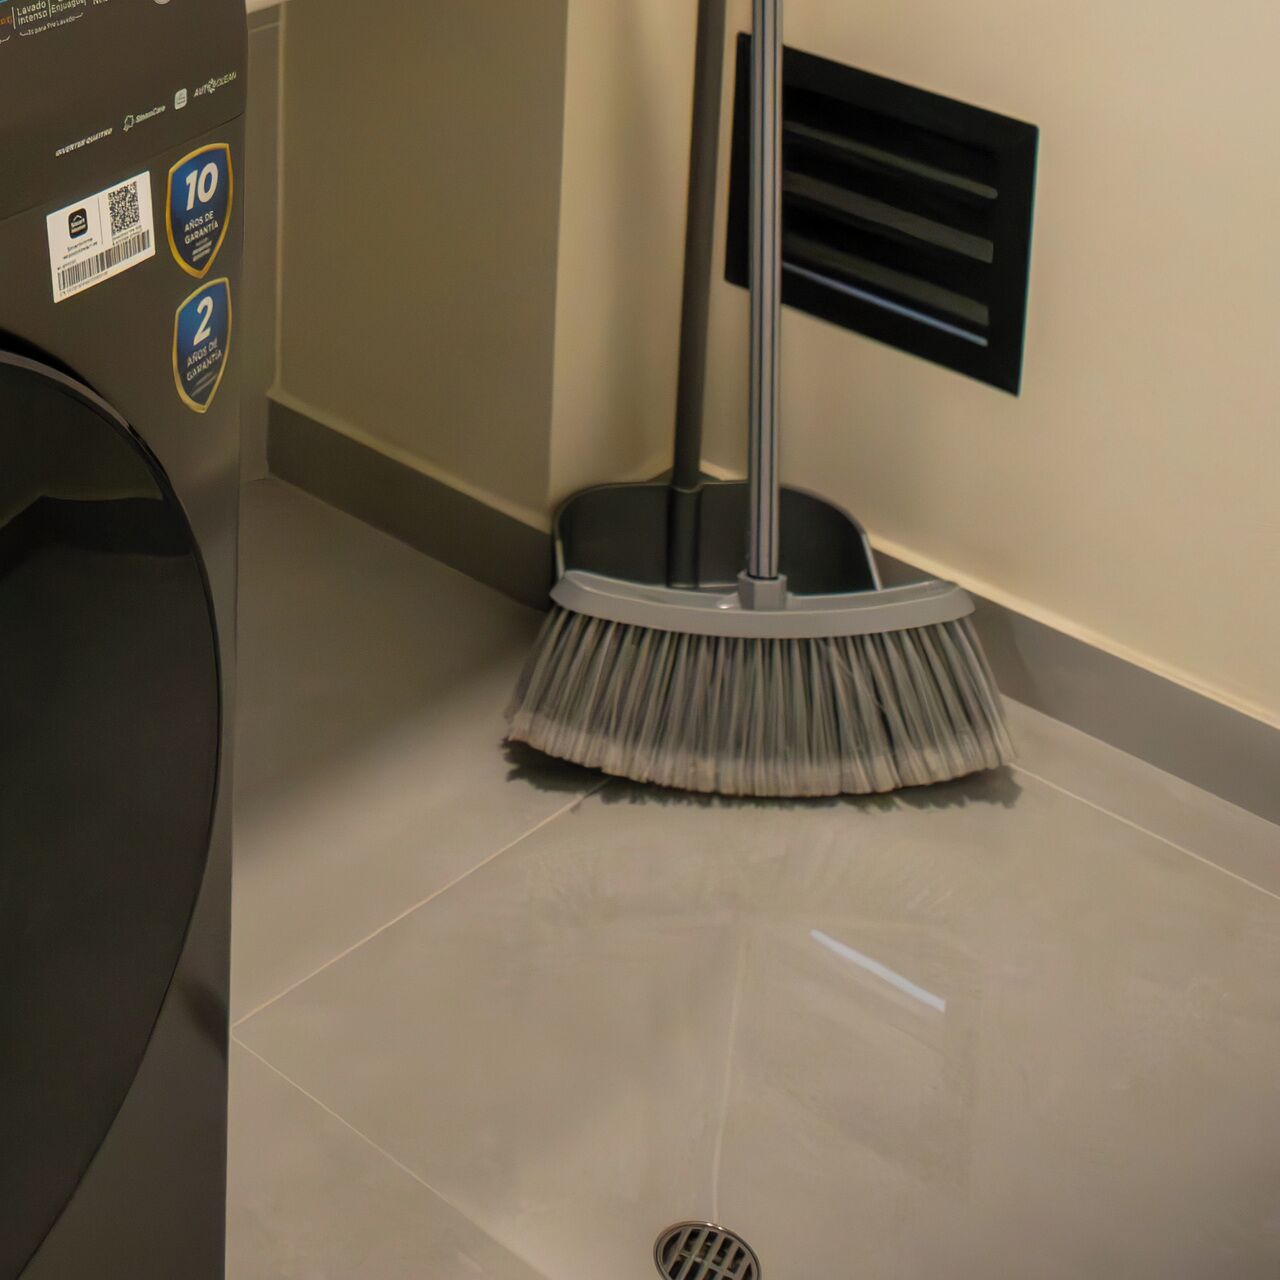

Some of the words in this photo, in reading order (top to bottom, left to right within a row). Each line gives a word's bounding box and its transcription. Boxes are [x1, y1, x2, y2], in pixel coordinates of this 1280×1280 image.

[17, 1, 47, 16] Lavado
[18, 10, 48, 26] Intenso
[186, 162, 218, 211] 10
[184, 216, 204, 232] AÑOS
[205, 211, 214, 222] DE
[184, 220, 219, 244] GARANTÍA
[193, 296, 214, 346] 2
